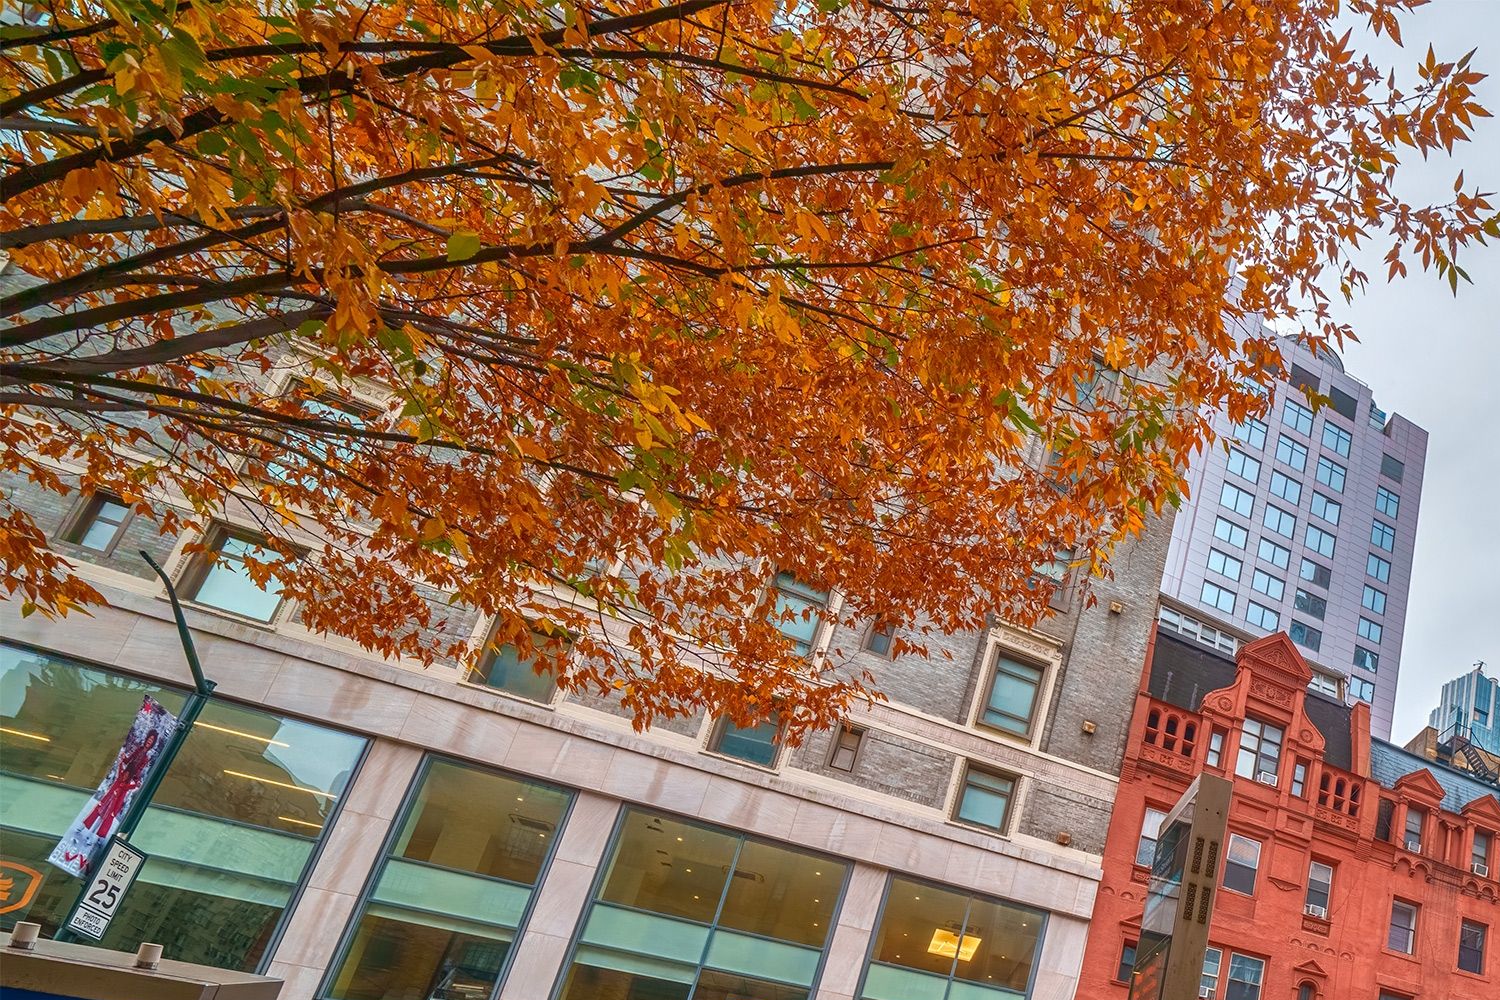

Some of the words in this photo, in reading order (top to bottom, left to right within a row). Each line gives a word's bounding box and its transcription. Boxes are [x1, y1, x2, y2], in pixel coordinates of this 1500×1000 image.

[118, 850, 133, 862] CITY
[110, 859, 130, 874] SPEED
[106, 869, 123, 882] LIMIT
[88, 879, 121, 909] 25
[73, 917, 102, 934] ENFORCED
[83, 912, 101, 925] PHOTO
